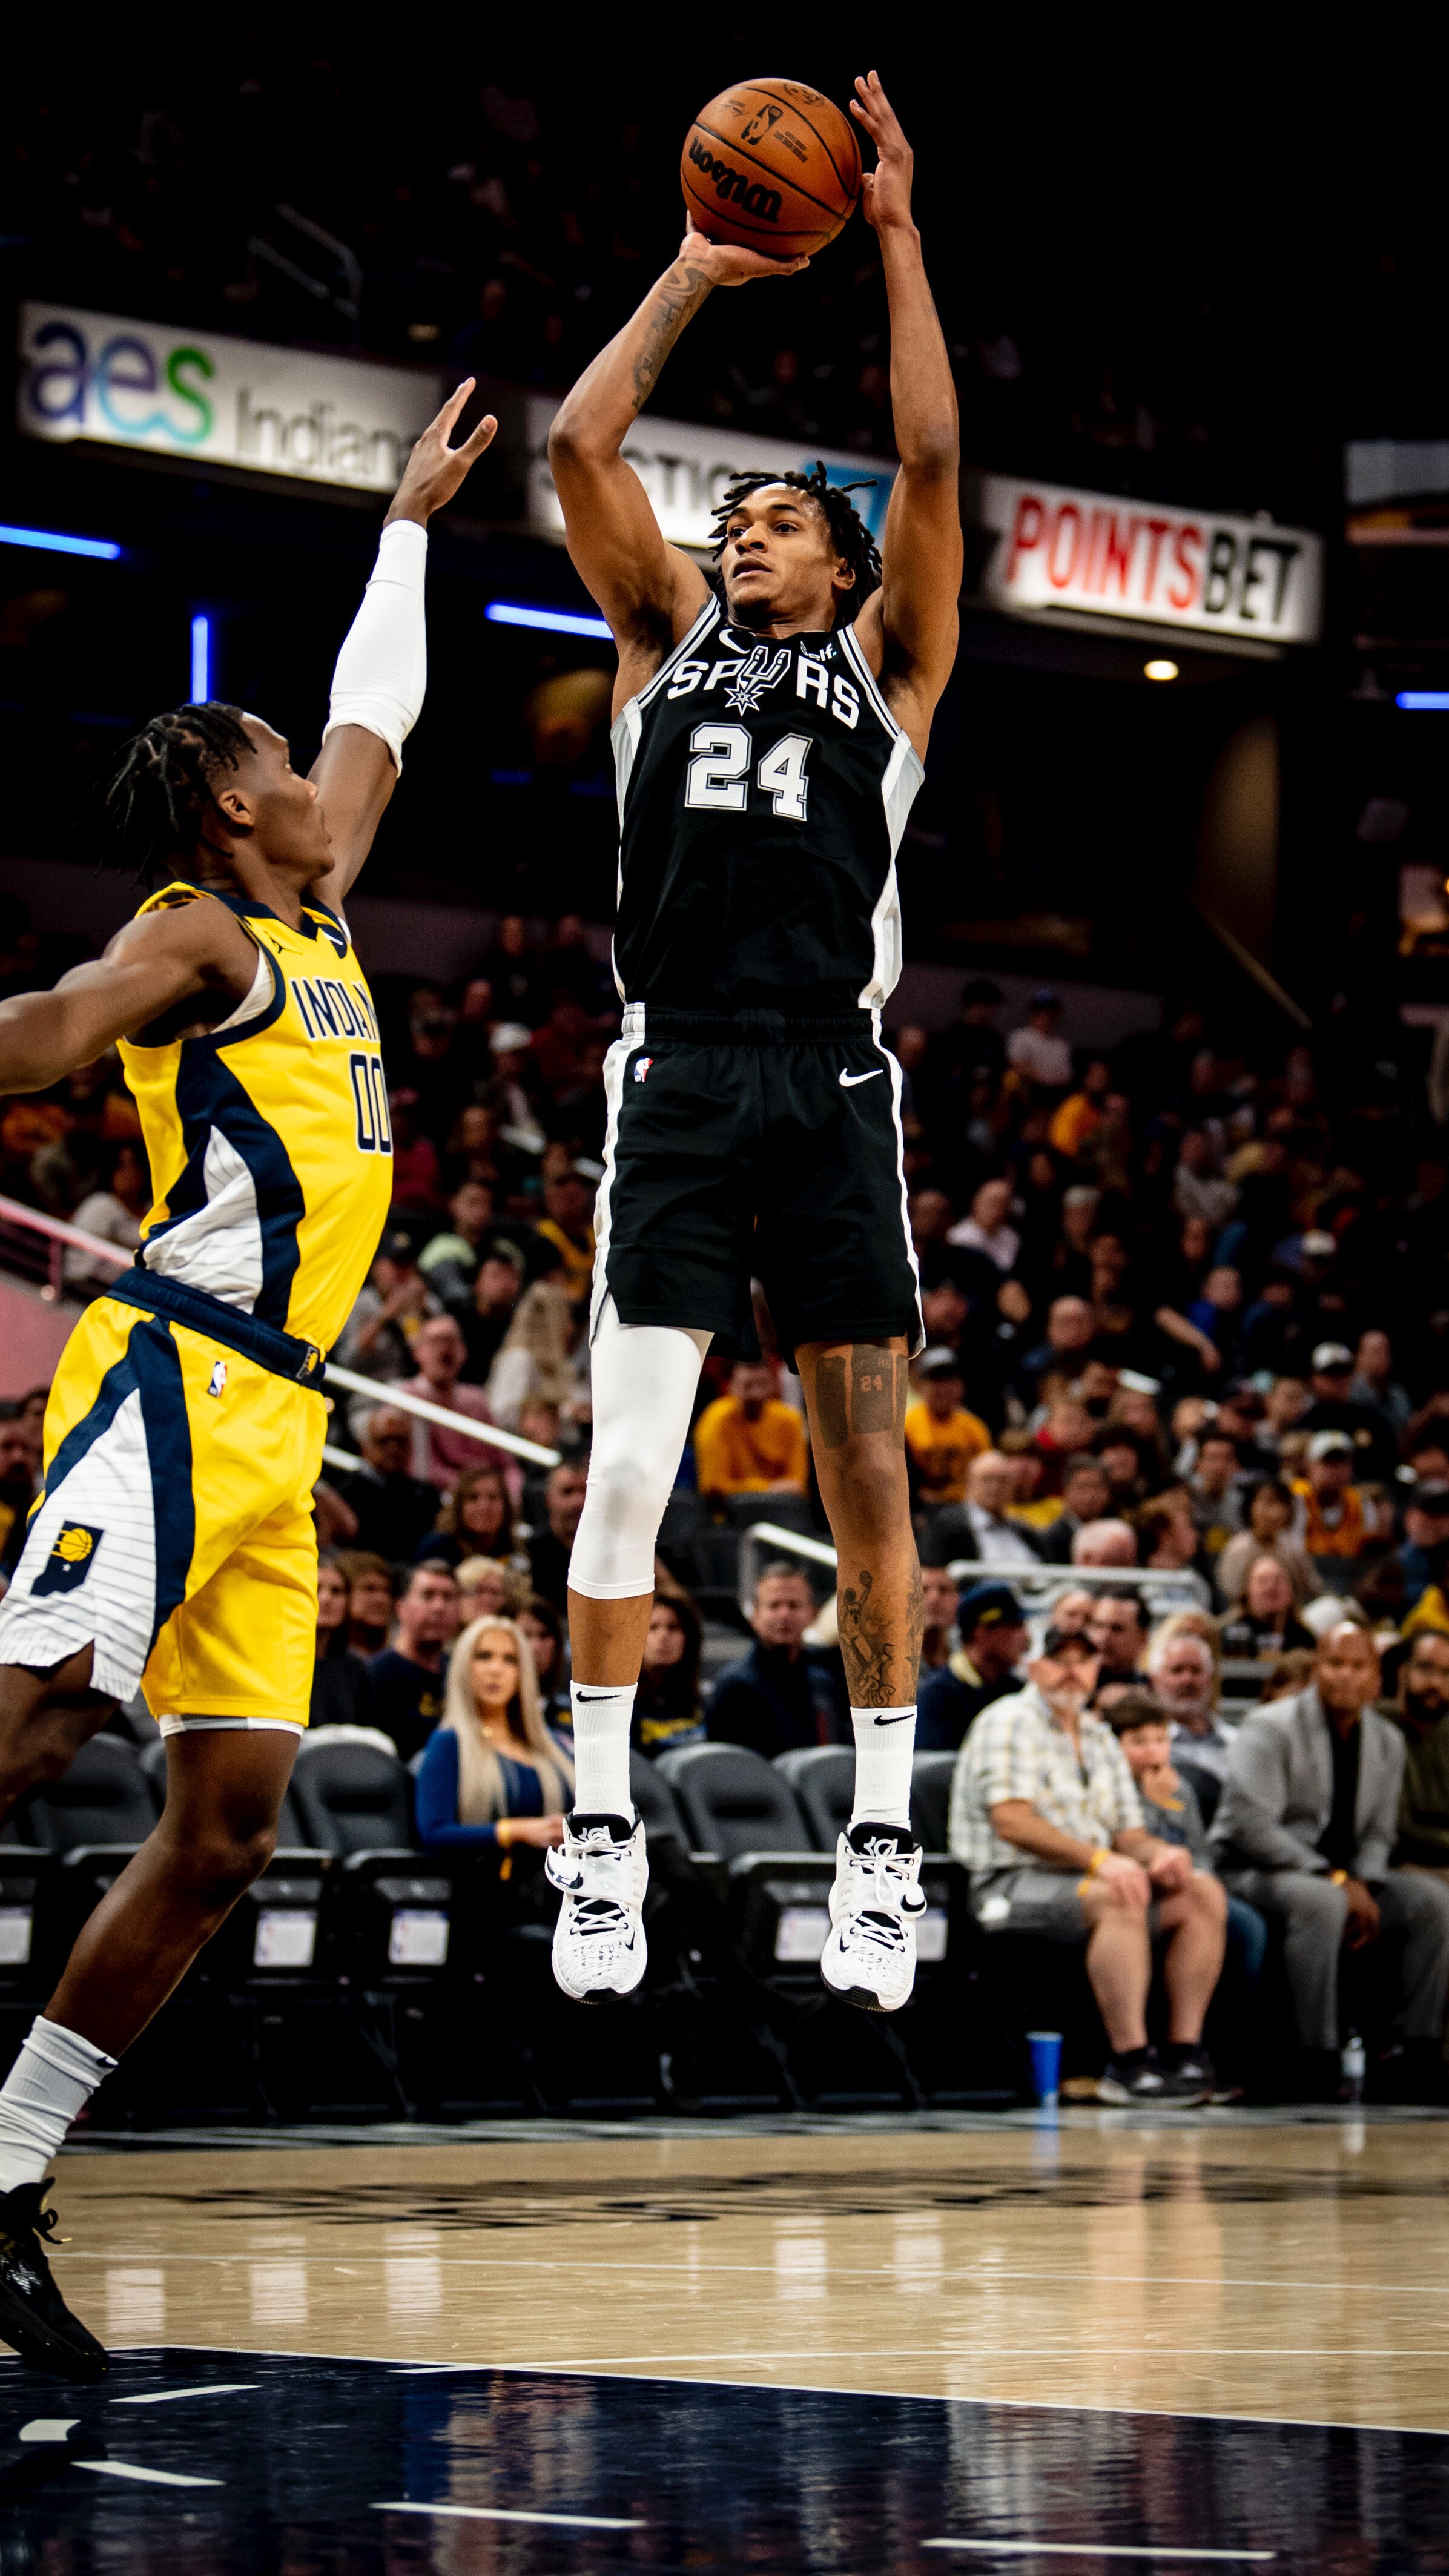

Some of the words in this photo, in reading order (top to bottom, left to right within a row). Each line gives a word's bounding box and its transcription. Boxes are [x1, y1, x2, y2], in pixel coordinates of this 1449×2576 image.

[688, 136, 783, 223] Wilson
[29, 321, 215, 446] aes
[1004, 495, 1302, 625] POINTSBET
[684, 722, 813, 821] 24
[349, 1050, 393, 1156] 00
